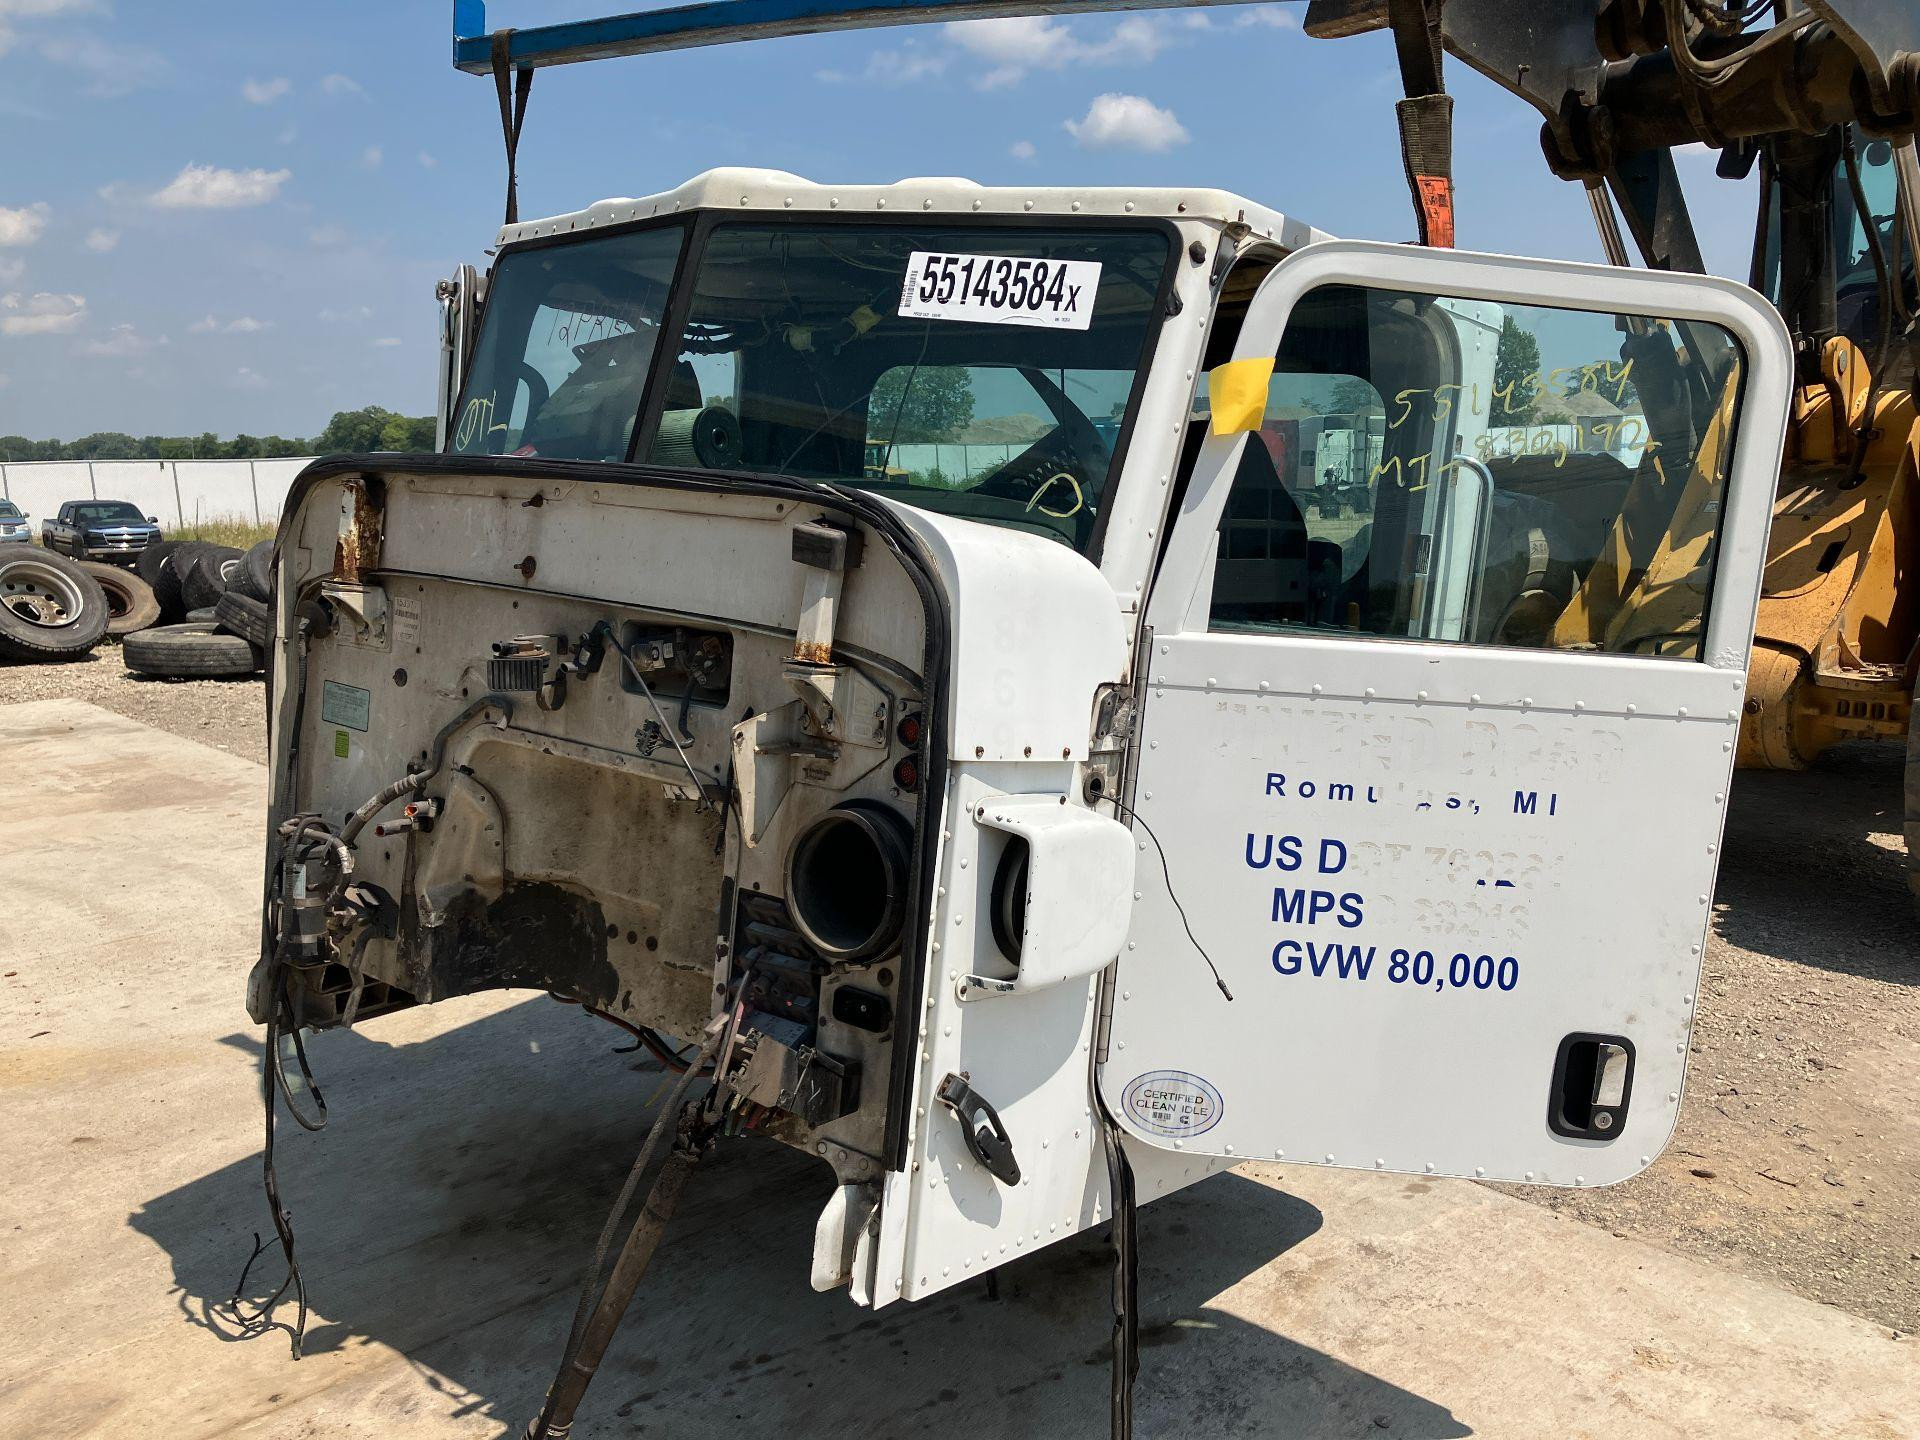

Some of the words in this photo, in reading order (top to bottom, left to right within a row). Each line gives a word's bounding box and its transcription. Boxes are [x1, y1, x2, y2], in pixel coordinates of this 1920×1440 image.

[1513, 790, 1557, 816] MI
[1245, 833, 1303, 872] US
[1271, 887, 1364, 929] MPS
[1271, 939, 1377, 981] GVW
[1387, 948, 1519, 993] 80,000
[1136, 1099, 1176, 1112] CLEAN
[1181, 1105, 1208, 1116] IDLE
[1143, 1089, 1204, 1105] CERTIFIED
